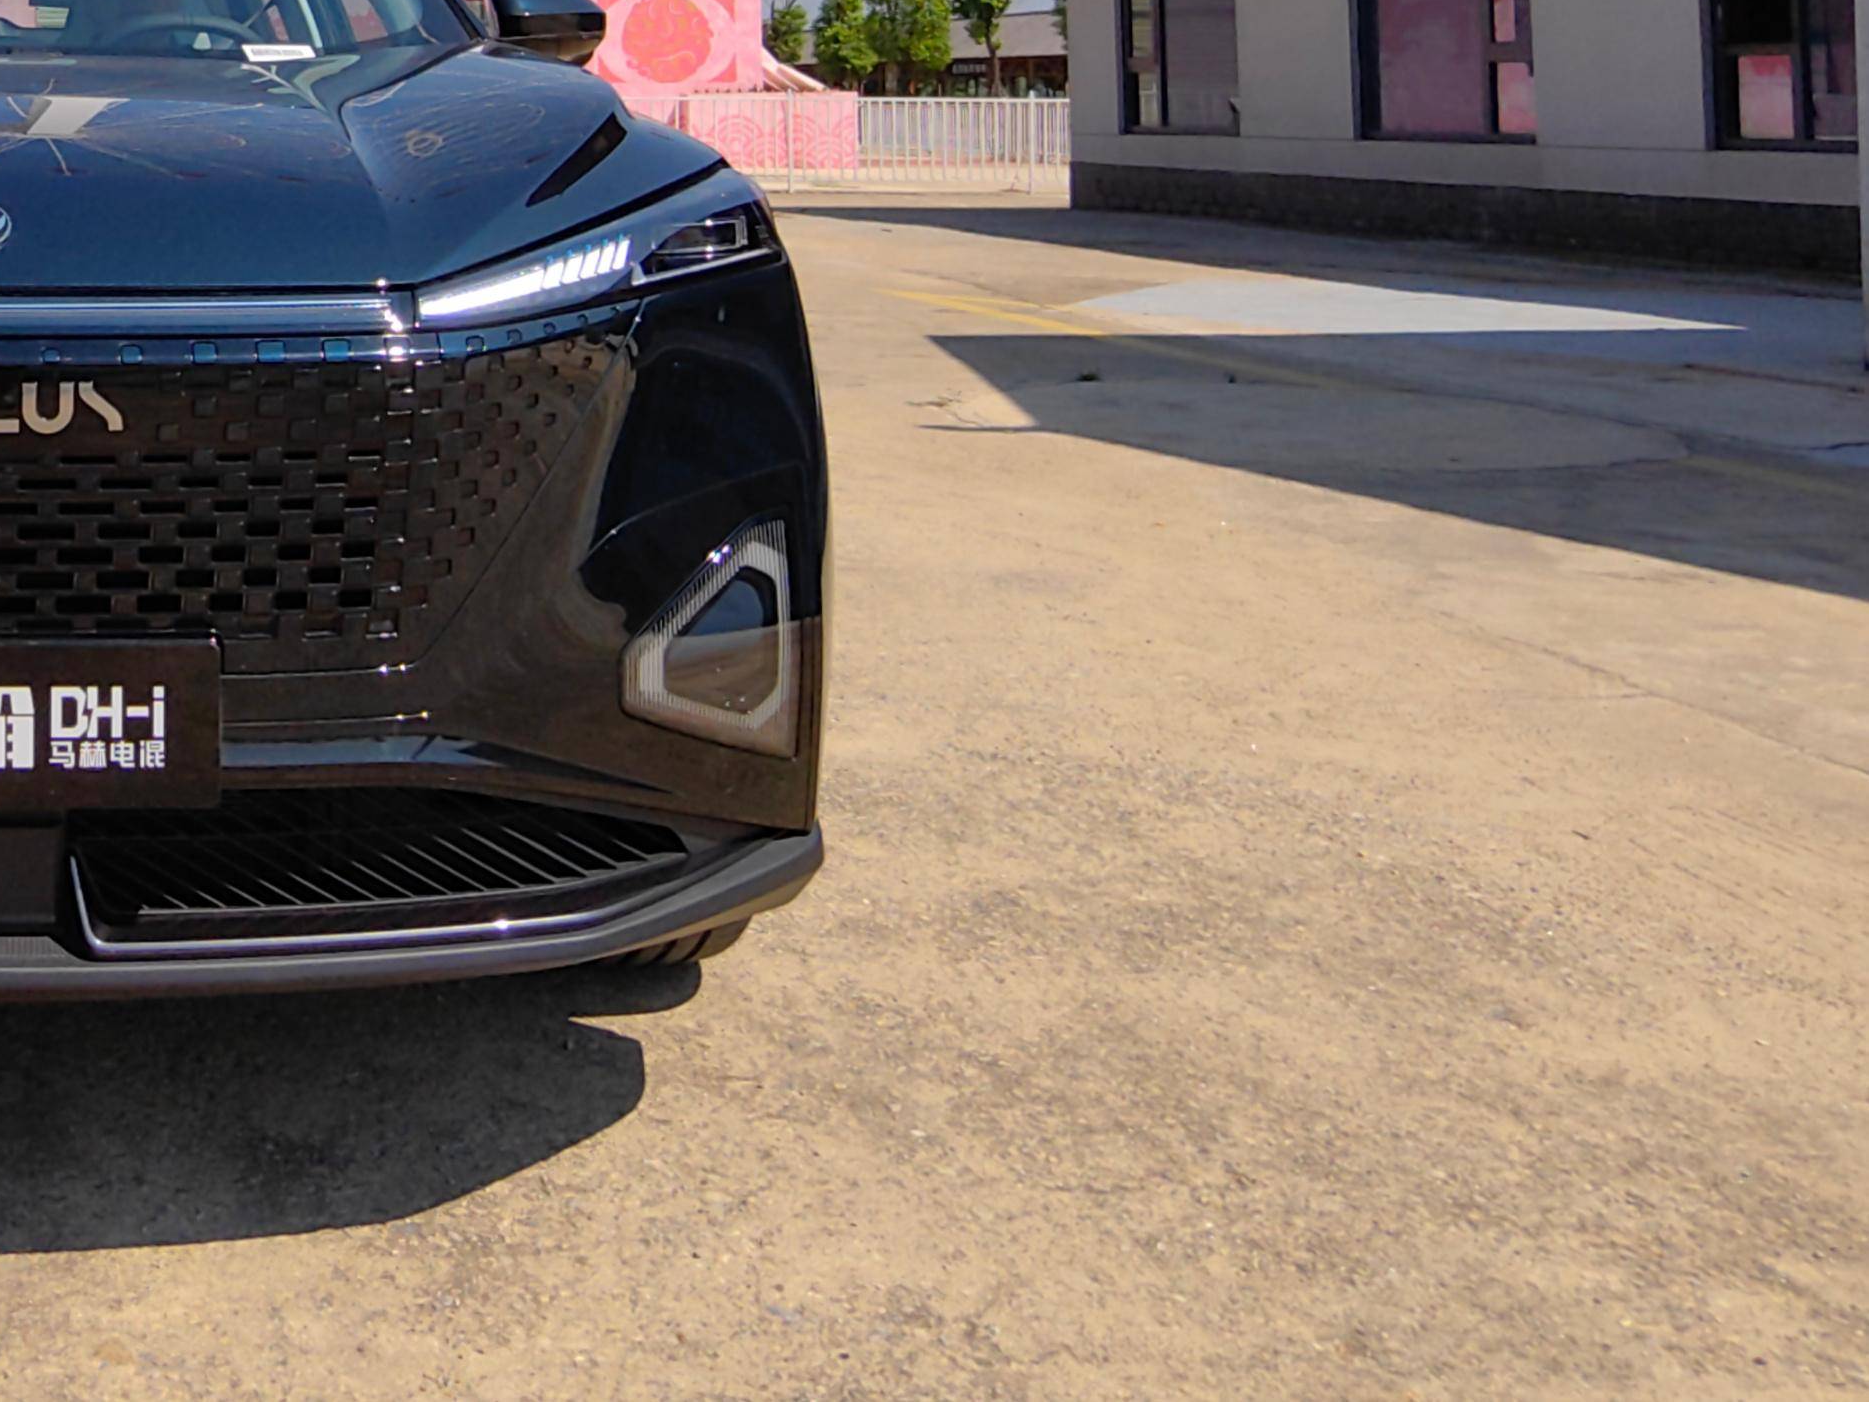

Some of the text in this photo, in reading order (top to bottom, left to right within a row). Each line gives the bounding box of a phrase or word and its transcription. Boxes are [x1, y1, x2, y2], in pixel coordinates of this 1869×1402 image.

[50, 685, 165, 738] DH-i
[48, 740, 165, 769] 马赫电混
